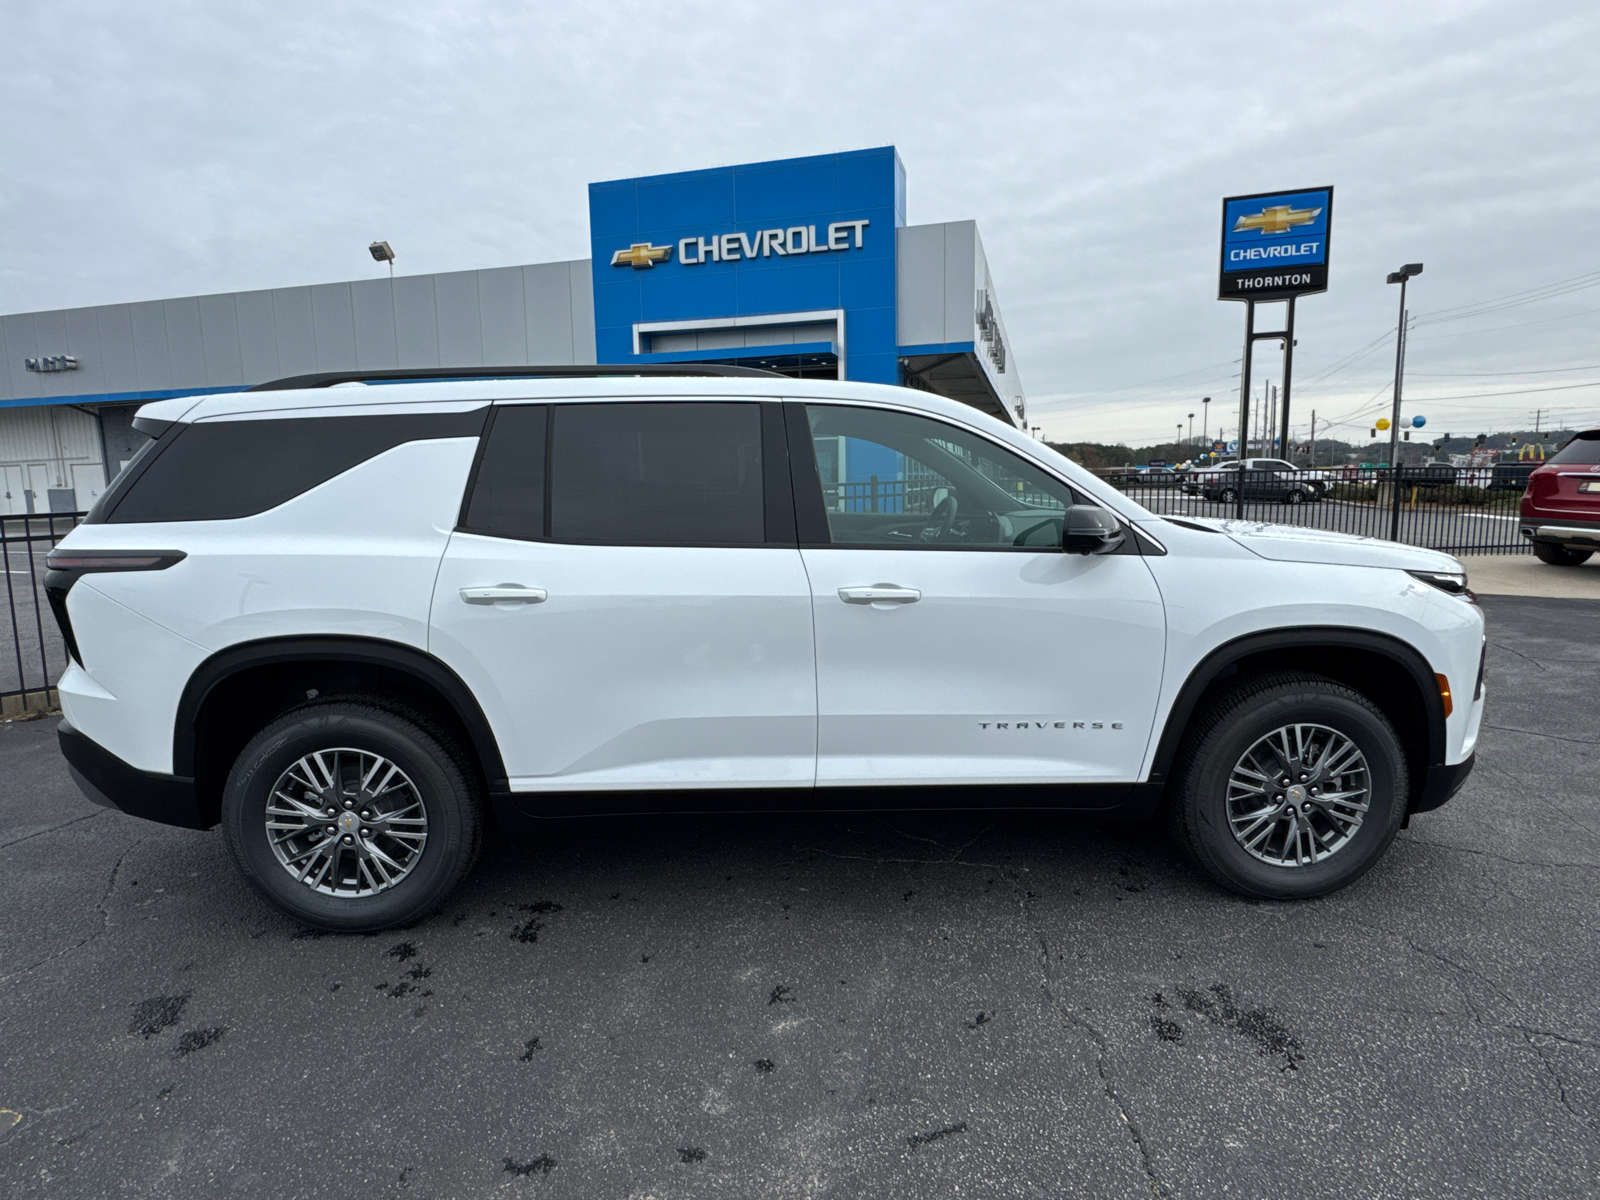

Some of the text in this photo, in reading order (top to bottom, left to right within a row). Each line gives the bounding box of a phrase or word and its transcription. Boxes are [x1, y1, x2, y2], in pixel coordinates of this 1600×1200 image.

[679, 220, 869, 265] CHEVROLET
[1230, 242, 1319, 261] CHEVROLET
[1237, 274, 1311, 289] THORNTON
[26, 355, 74, 372] PARTS
[978, 721, 1124, 730] TRAVERSE
